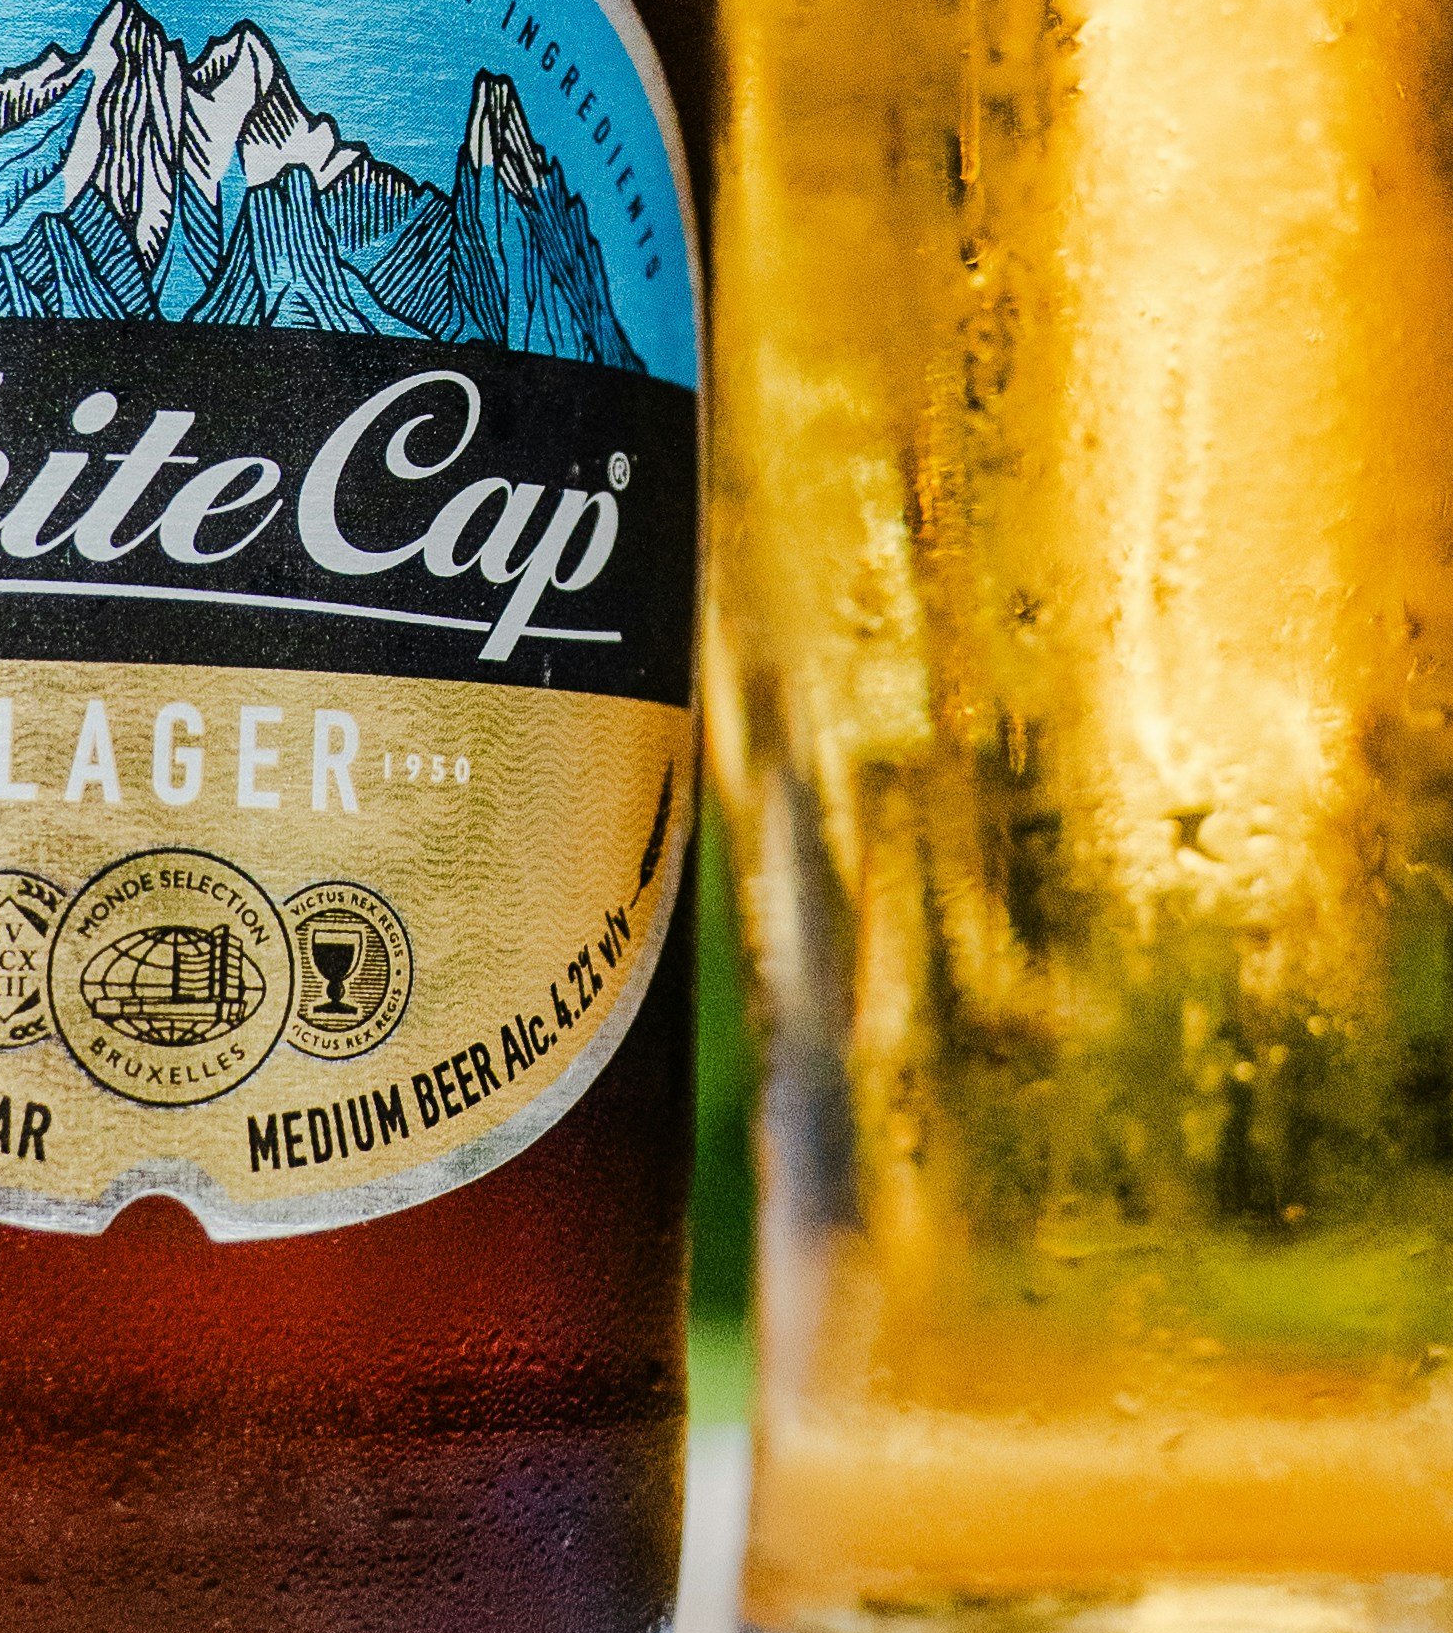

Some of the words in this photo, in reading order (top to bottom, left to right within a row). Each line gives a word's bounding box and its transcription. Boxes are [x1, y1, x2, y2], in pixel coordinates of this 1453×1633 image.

[501, 0, 662, 280] INGREDIENTS
[382, 752, 472, 785] 1950
[76, 870, 155, 941] MONDE
[159, 869, 271, 947] SELECTION
[289, 891, 345, 916] VICTUS
[350, 893, 378, 917] REX
[378, 914, 404, 958] REGIS
[345, 1029, 375, 1049] REX
[374, 987, 403, 1031] REGIS
[87, 1038, 247, 1086] BRUXELLES
[246, 1083, 411, 1173] MEDIUM
[410, 1041, 503, 1130] BEER
[499, 1013, 559, 1082] Alc.
[550, 944, 605, 1031] 4.2%
